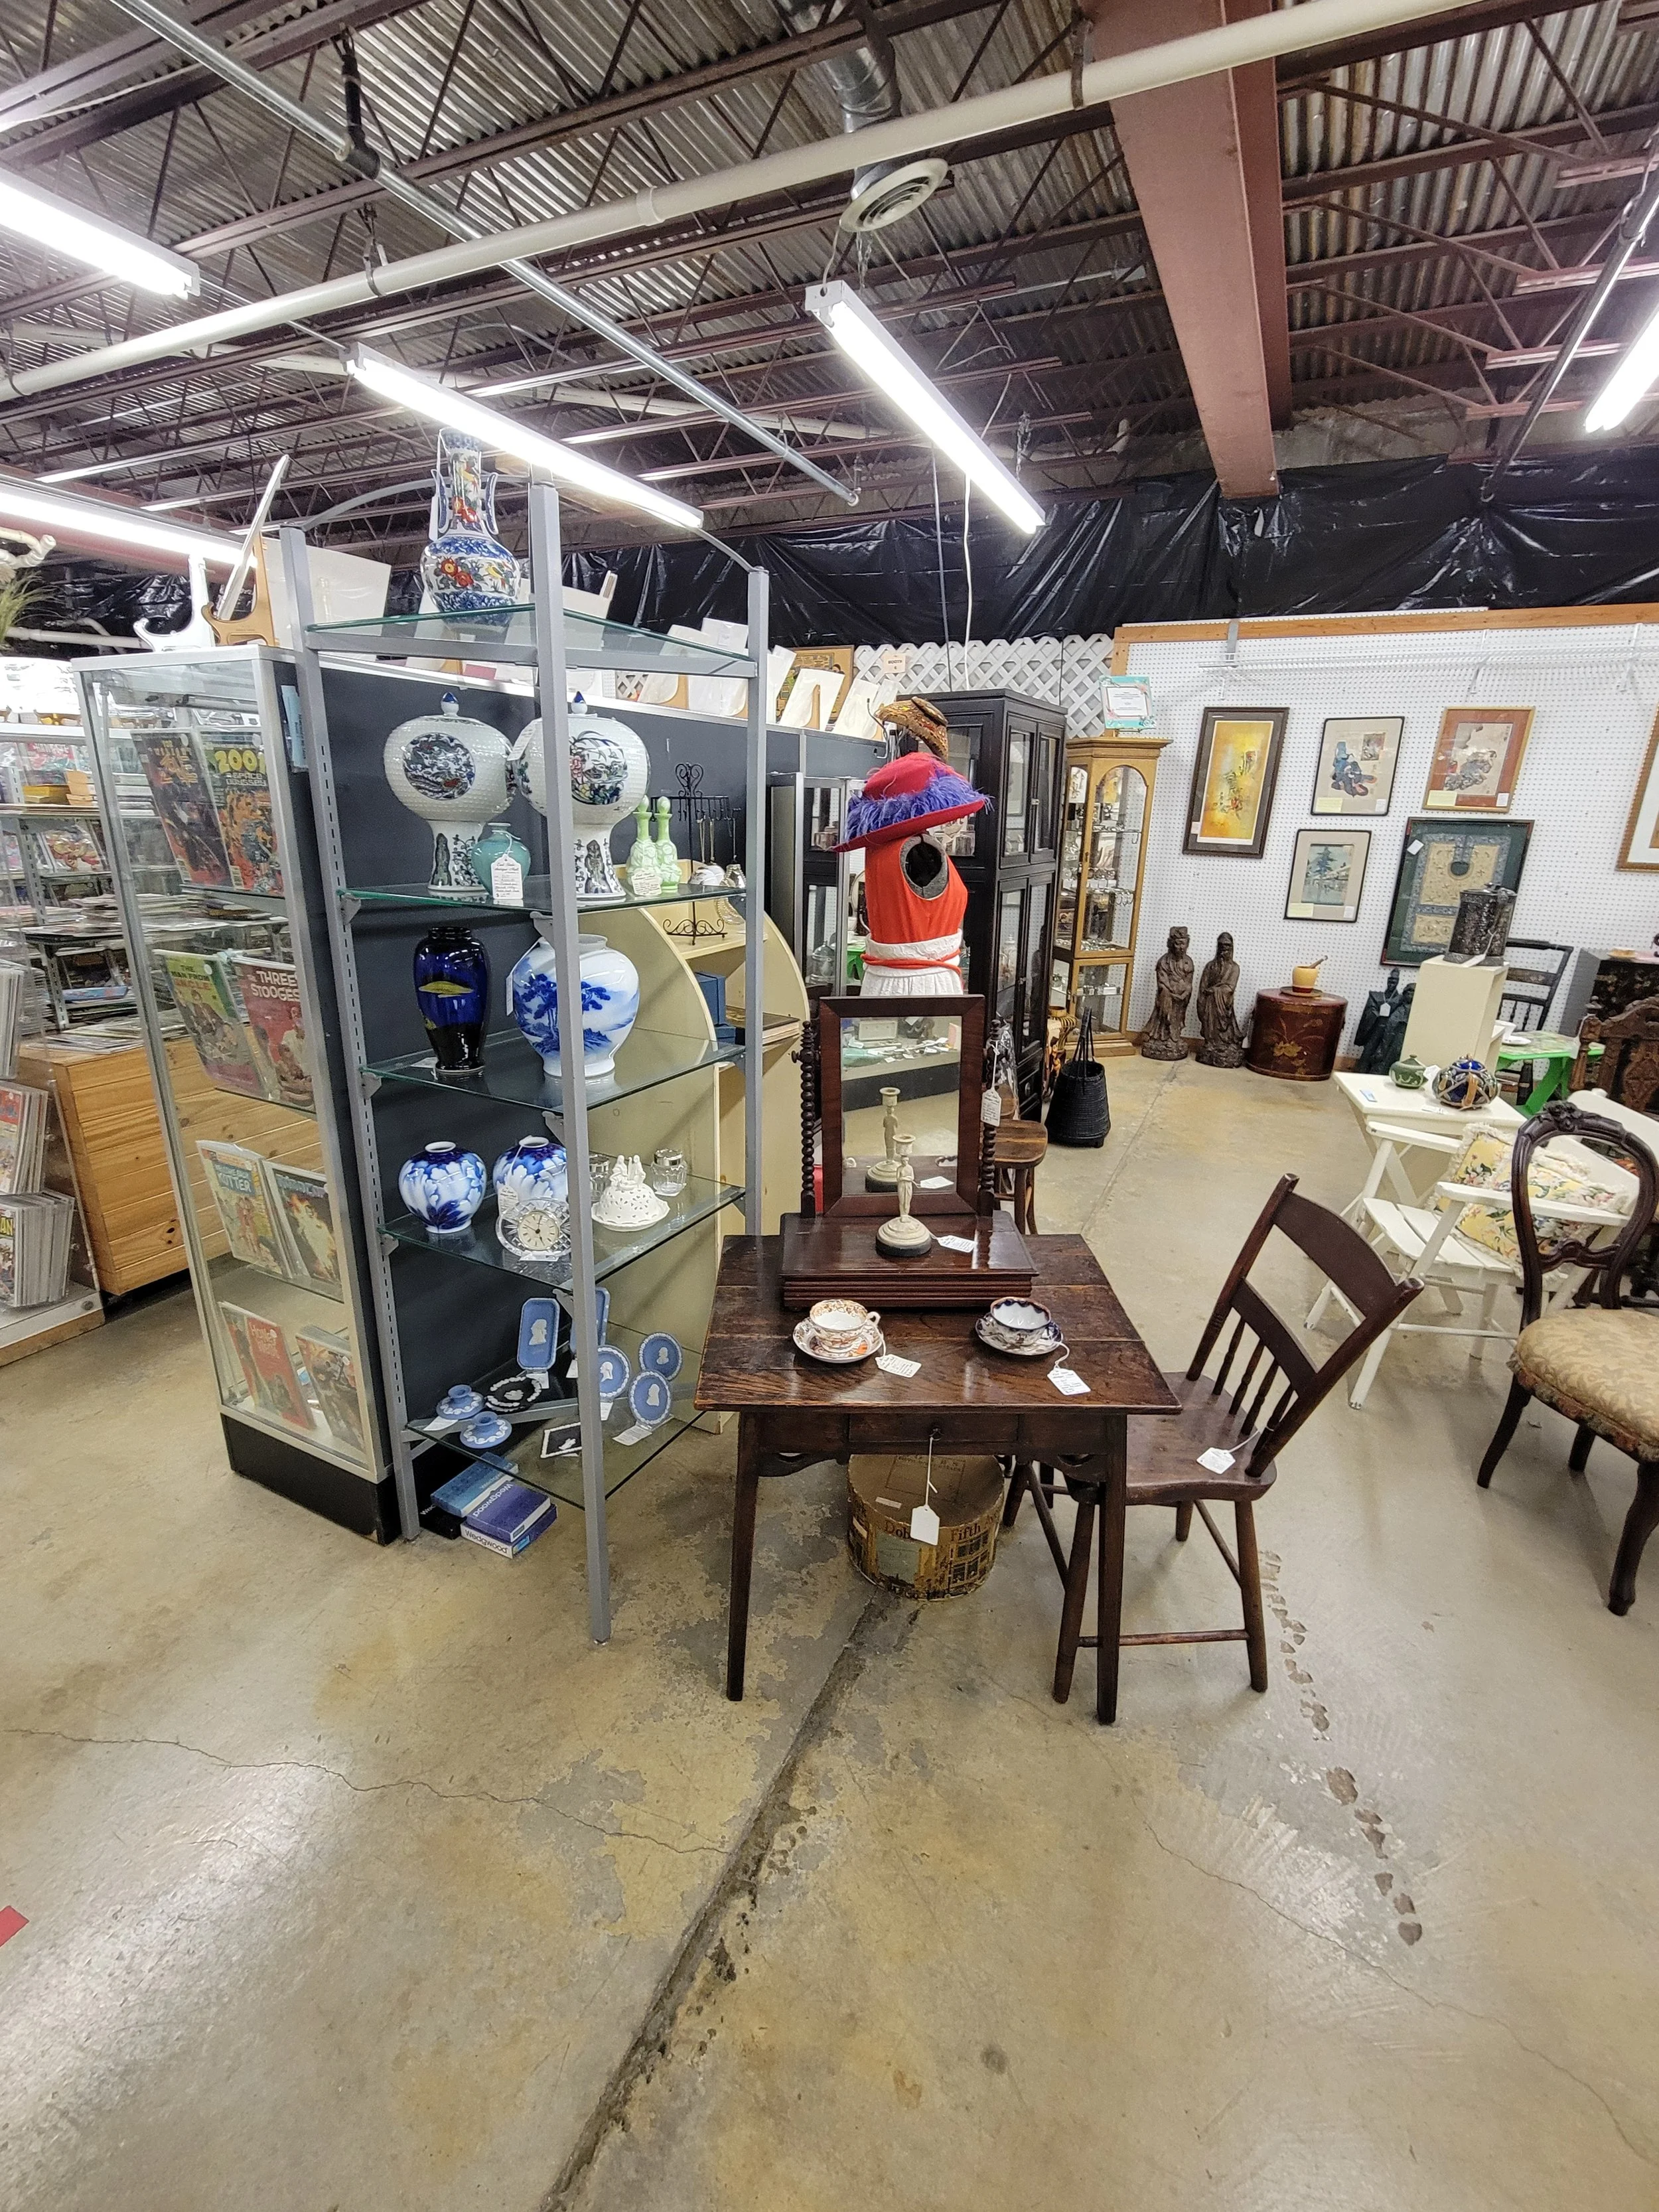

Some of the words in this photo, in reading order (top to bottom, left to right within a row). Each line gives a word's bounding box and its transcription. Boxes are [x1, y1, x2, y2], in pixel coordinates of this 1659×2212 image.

[256, 970, 298, 987] THREE
[251, 983, 301, 1002] STOOGES
[0, 1217, 13, 1236] AN
[472, 1483, 514, 1517] Wedgwood
[885, 1519, 912, 1540] Dob
[951, 1523, 981, 1542] Fifth
[465, 1529, 508, 1554] Wedgwood
